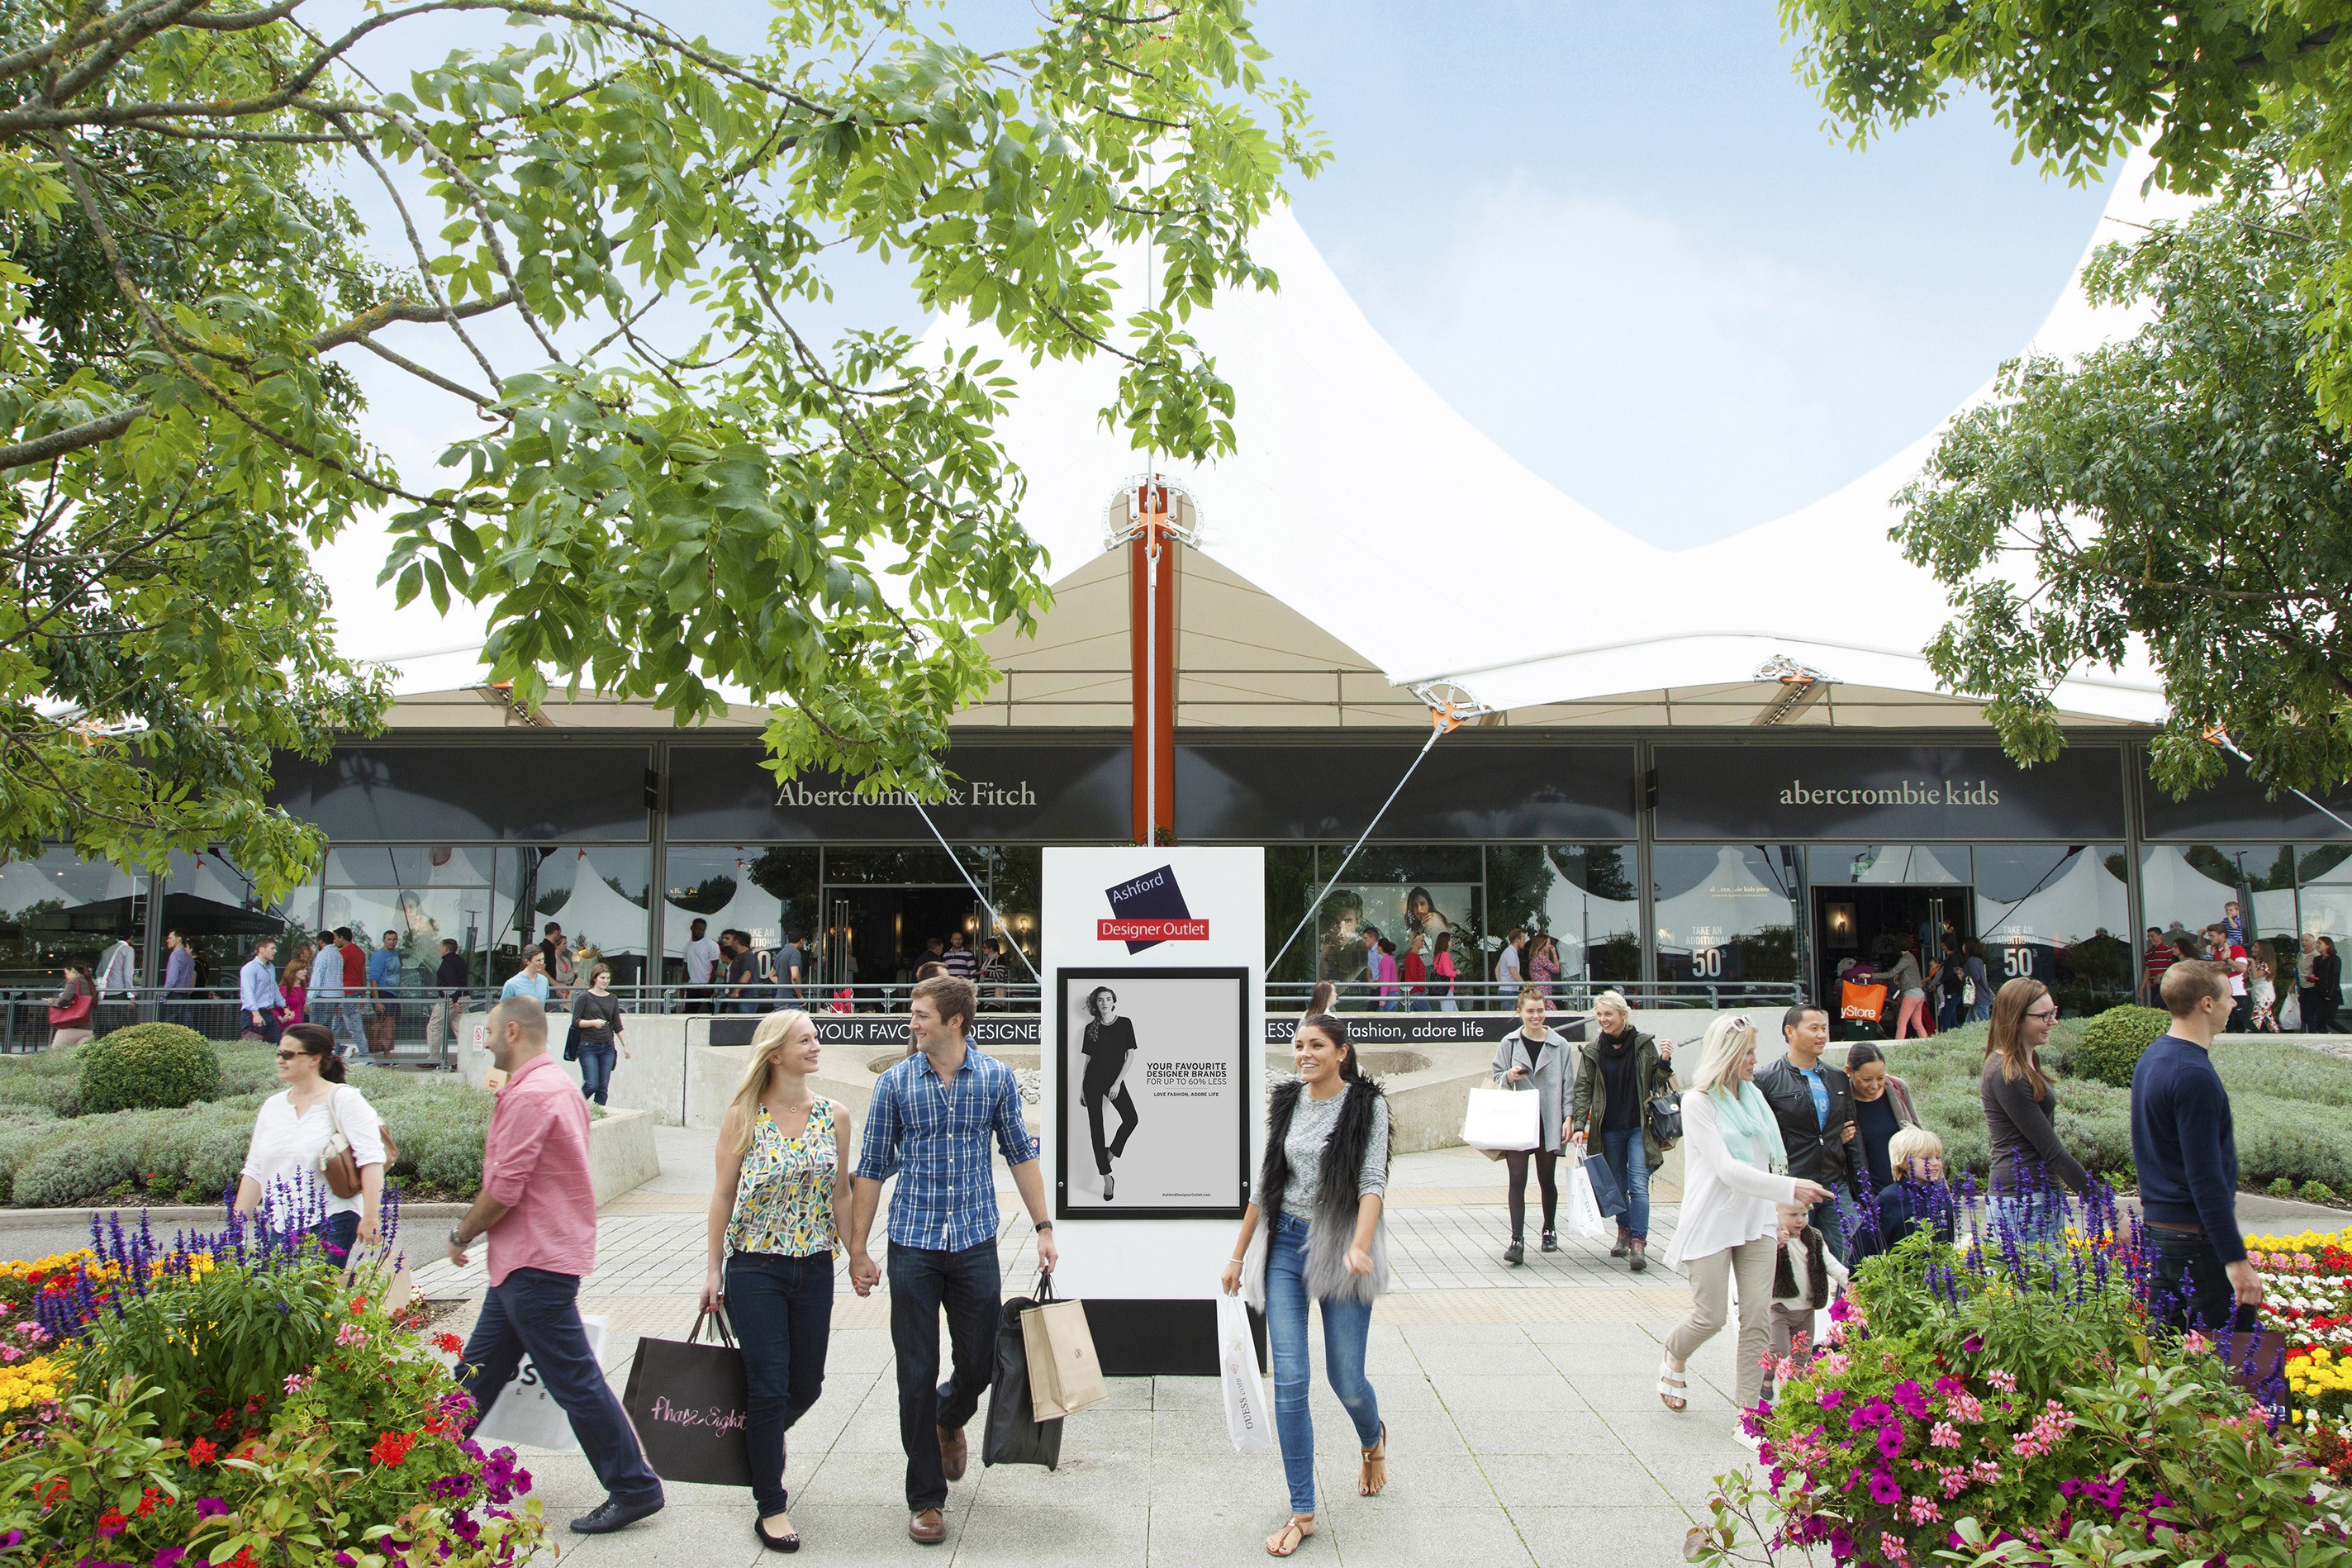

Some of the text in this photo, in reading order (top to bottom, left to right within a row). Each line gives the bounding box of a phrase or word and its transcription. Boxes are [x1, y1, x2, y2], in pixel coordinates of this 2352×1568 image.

[946, 788, 967, 806] &
[971, 781, 1037, 806] Fitch
[1779, 779, 1999, 805] abercrombie kids
[1113, 872, 1165, 903] Ashford
[764, 928, 775, 937] AN
[1102, 922, 1205, 939] Designer Outlet
[1692, 926, 1722, 935] TAKE AN
[2003, 926, 2033, 934] TAKE AN
[1686, 936, 1728, 945] ADDITIONAL
[1997, 936, 2039, 945] ADDITIONAL
[816, 1024, 864, 1039] YOUR
[1347, 1021, 1407, 1039] fashion,
[1412, 1021, 1456, 1038] adore
[1462, 1021, 1485, 1037] life
[651, 1395, 747, 1438] Phase Eight
